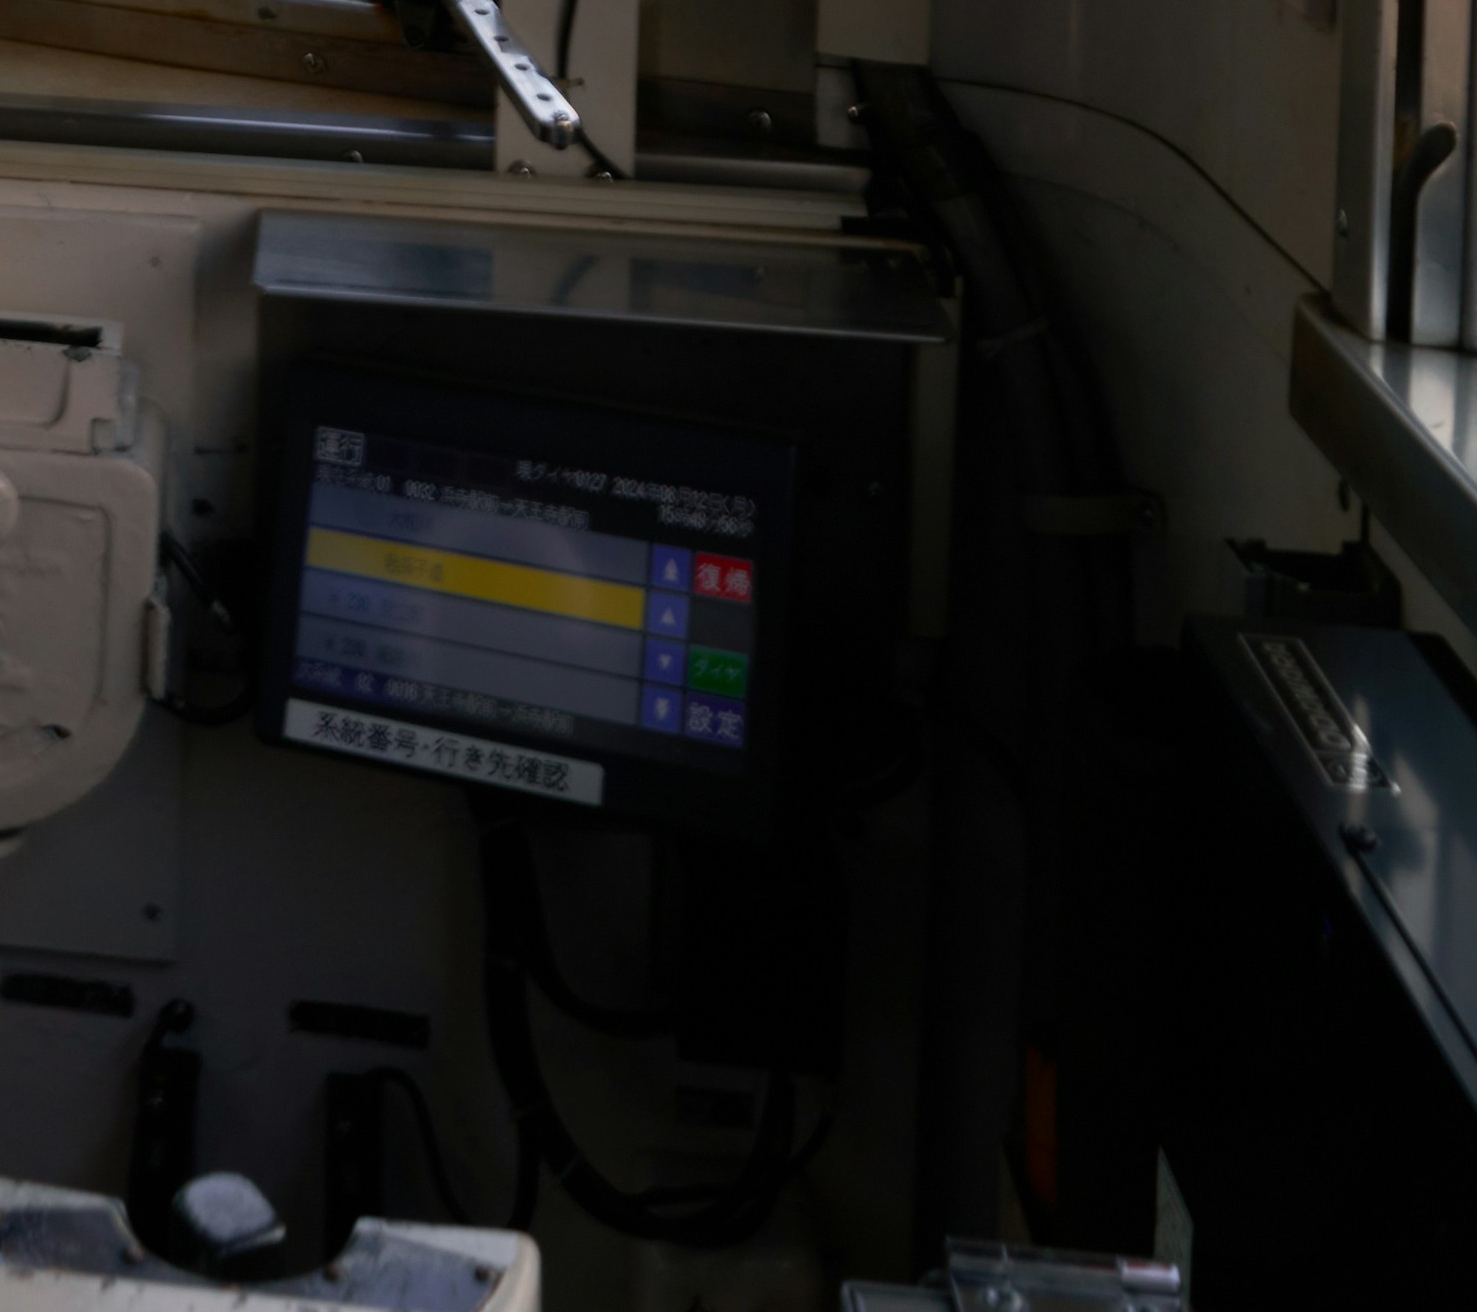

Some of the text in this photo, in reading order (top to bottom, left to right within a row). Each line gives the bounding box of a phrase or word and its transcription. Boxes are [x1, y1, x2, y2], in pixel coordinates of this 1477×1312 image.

[694, 658, 742, 681] ダイヤ
[686, 700, 743, 740] 設定
[312, 710, 570, 793] 系統番号・行き先確認
